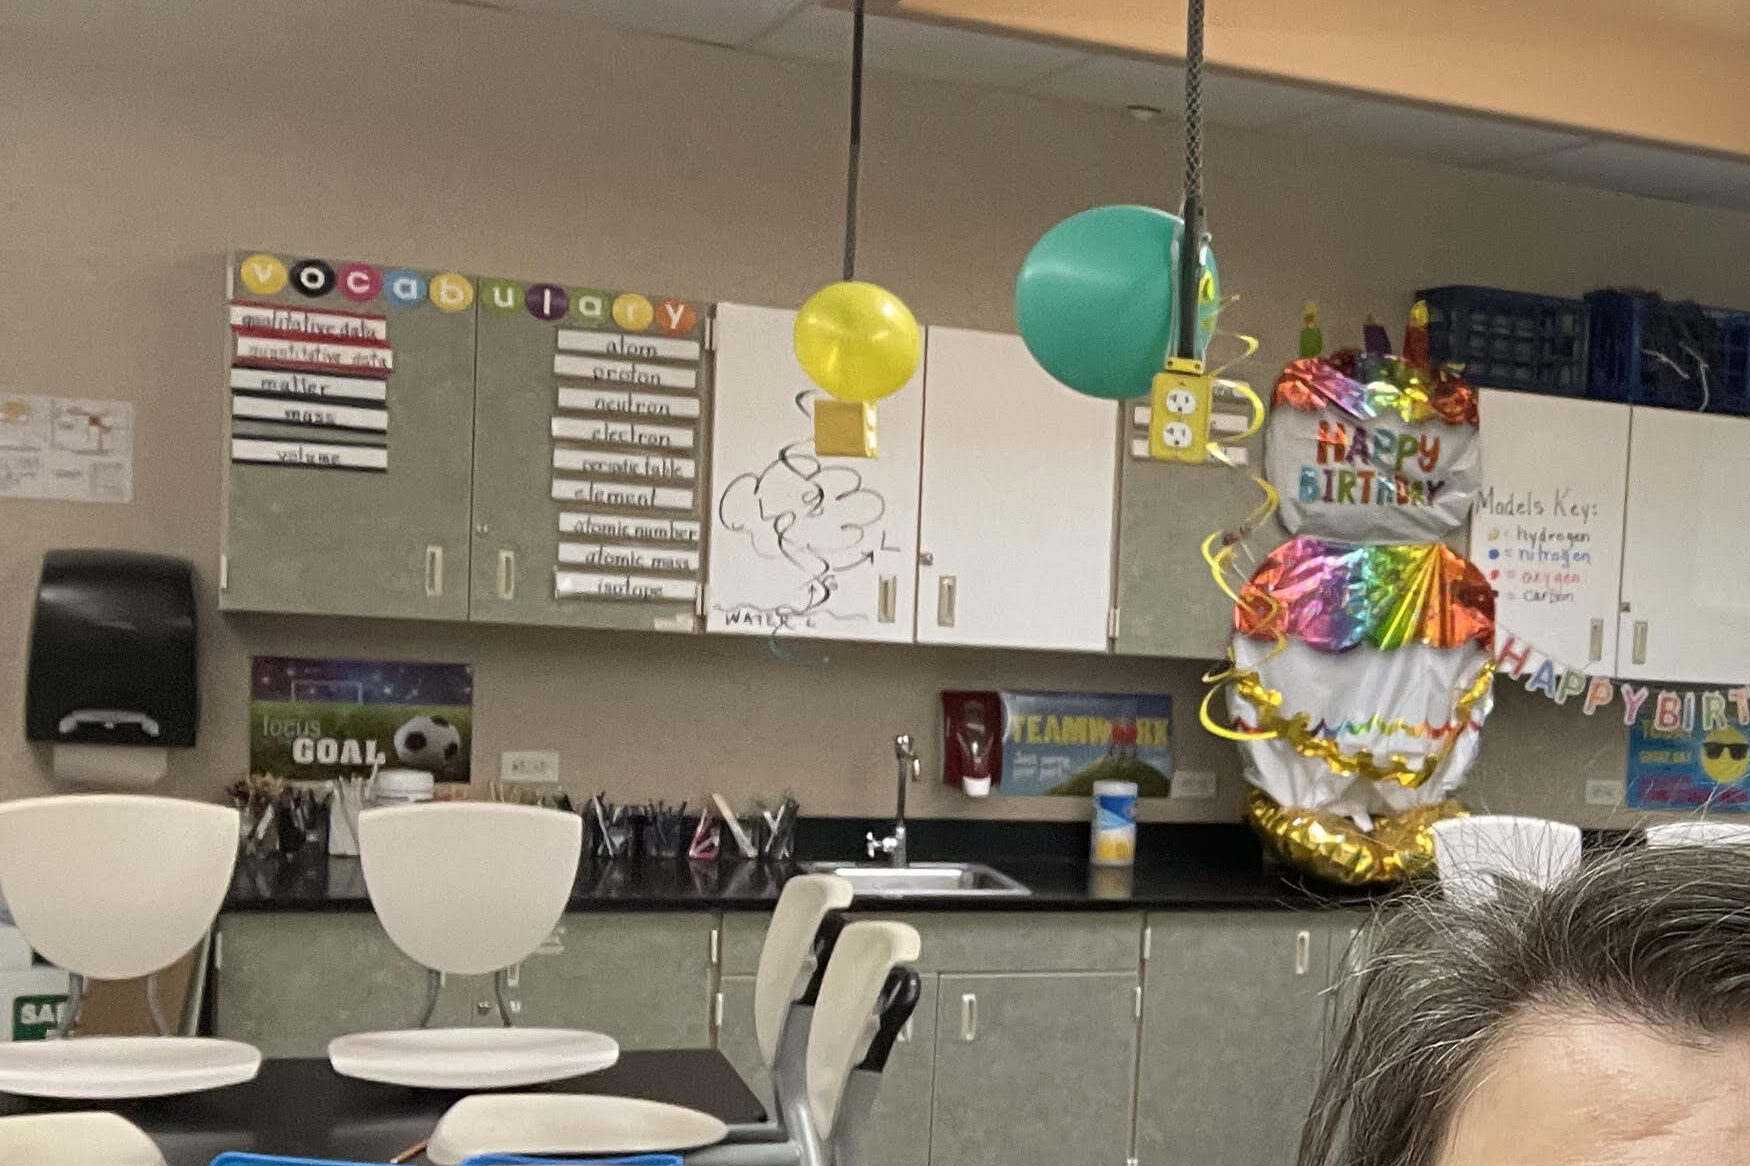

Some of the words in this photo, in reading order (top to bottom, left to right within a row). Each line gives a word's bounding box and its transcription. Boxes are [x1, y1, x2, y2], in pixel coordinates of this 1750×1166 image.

[606, 334, 658, 358] atom
[260, 372, 329, 396] matter
[592, 362, 661, 386] proton
[284, 408, 337, 426] mass
[594, 392, 672, 417] neutron
[592, 422, 671, 447] electron
[1316, 419, 1441, 473] HAPPY
[574, 480, 657, 507] element
[1298, 464, 1446, 506] BIRTHDAY
[1475, 486, 1545, 517] Models
[1553, 487, 1599, 525] Key:
[1516, 524, 1591, 550] hydrogen
[585, 545, 643, 569] atomic
[1519, 544, 1592, 569] nitrogen
[1494, 634, 1650, 726] HAPPY
[291, 737, 387, 766] GOAL
